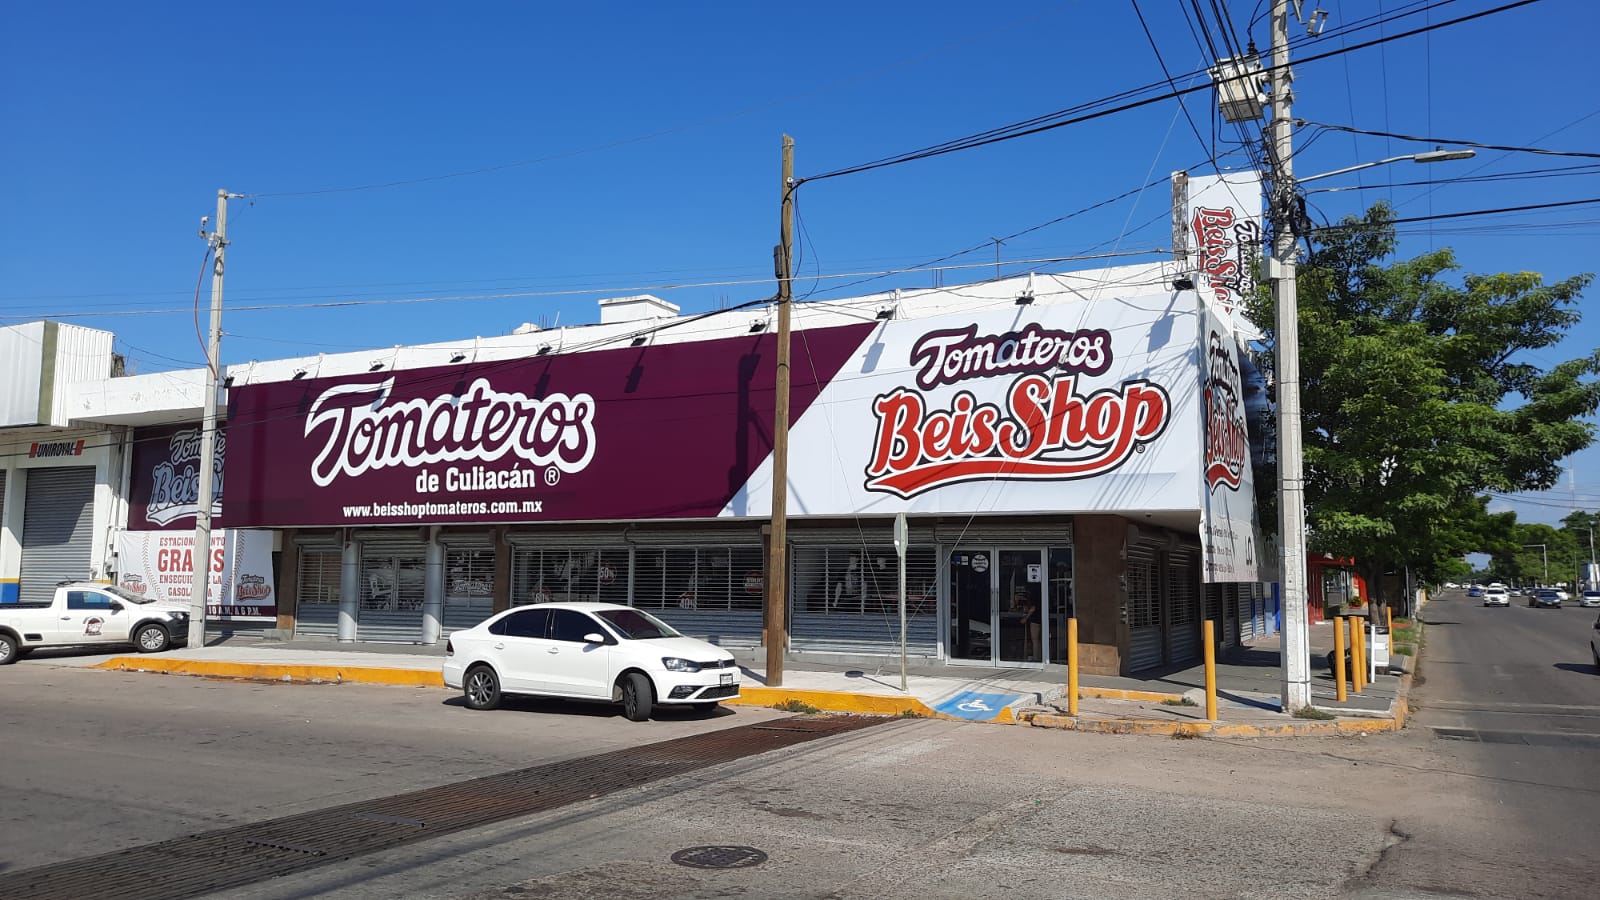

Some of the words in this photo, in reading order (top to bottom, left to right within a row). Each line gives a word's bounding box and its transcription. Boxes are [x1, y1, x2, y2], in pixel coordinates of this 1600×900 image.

[910, 323, 1112, 391] Tomateros
[304, 376, 597, 487] Tomateros
[37, 442, 75, 457] UNIROYAL
[416, 469, 439, 493] de
[446, 463, 535, 492] Culiacán
[343, 500, 543, 518] www.beisshoptomateros.com.mx
[158, 549, 225, 572] GRAIS
